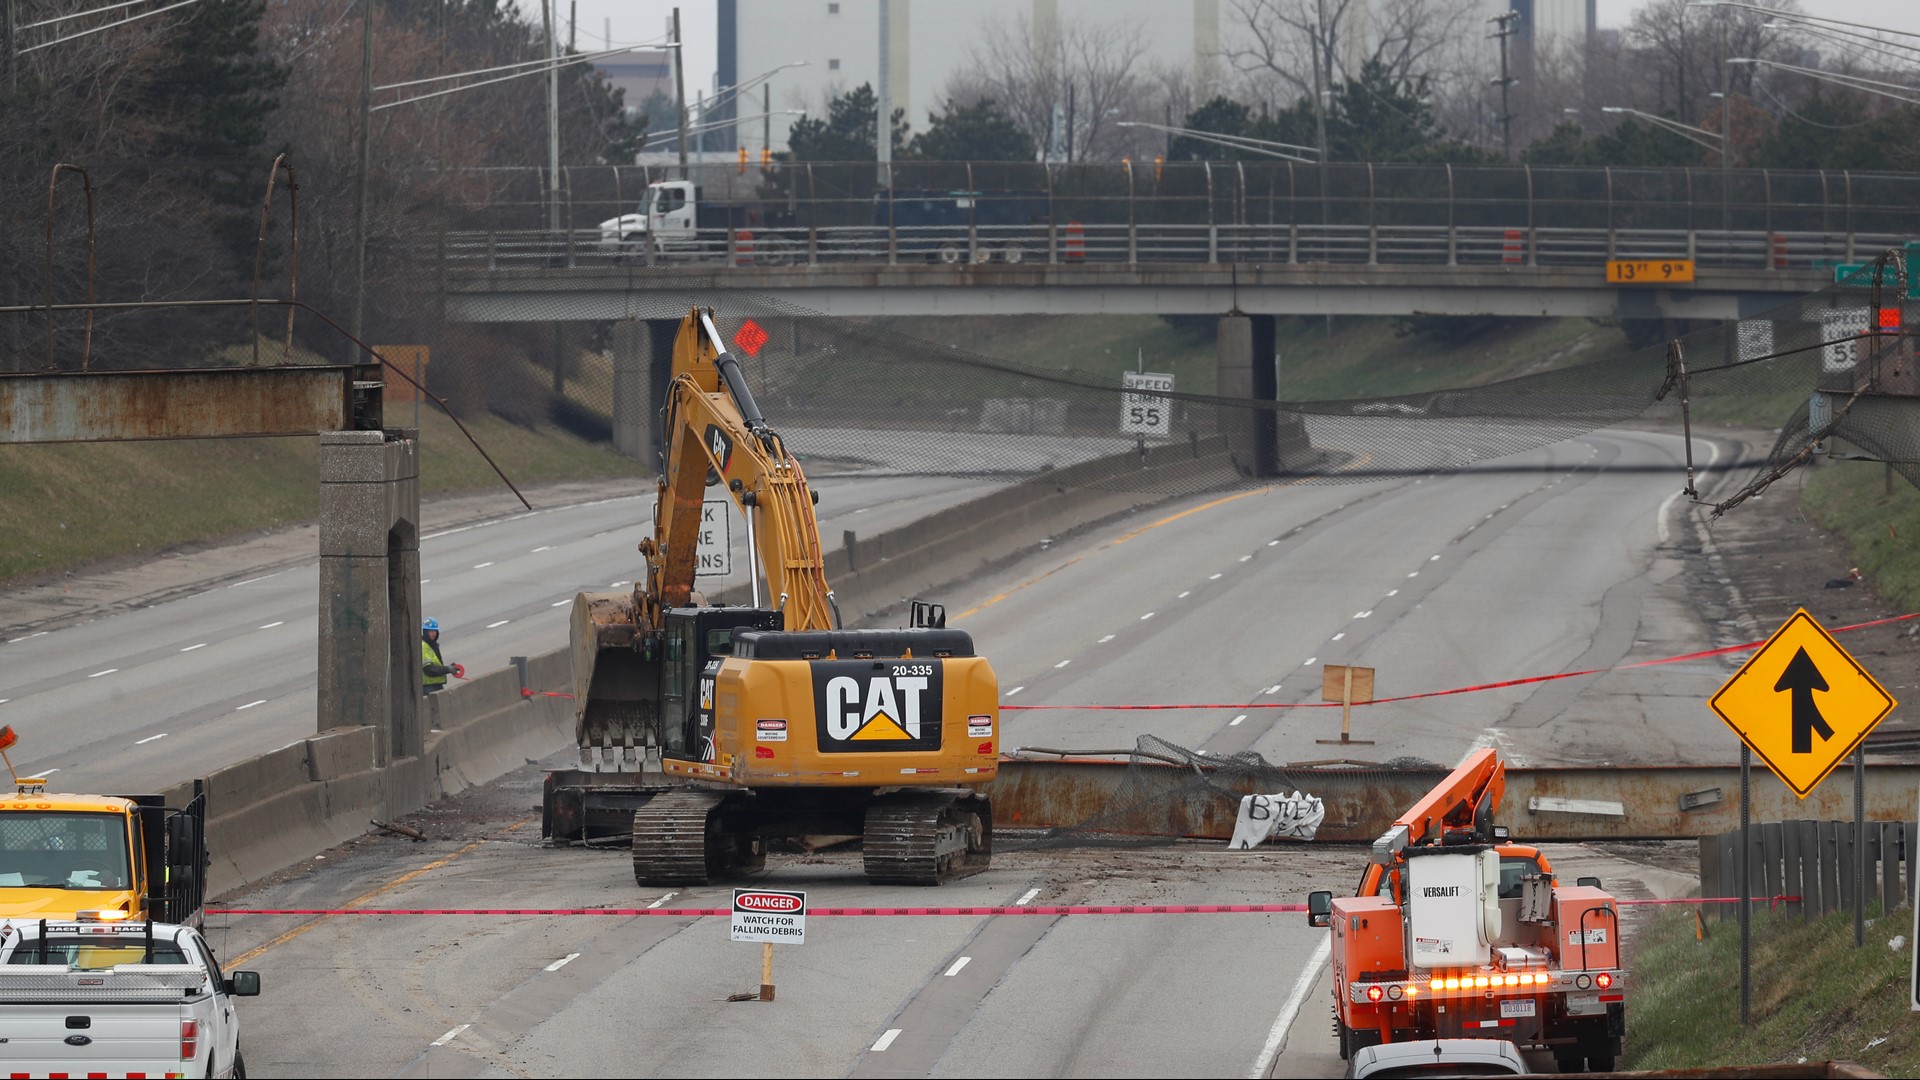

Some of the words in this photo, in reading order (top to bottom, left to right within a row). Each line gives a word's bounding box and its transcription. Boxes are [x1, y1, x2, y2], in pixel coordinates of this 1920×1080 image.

[1126, 378, 1171, 390] SPEED
[1130, 408, 1159, 426] 55
[713, 429, 726, 468] CAT
[892, 665, 933, 676] 20-335
[700, 678, 715, 710] CAT
[826, 676, 928, 740] CAT
[1423, 886, 1459, 898] VERSALIFT
[744, 896, 794, 909] DANGER
[743, 916, 774, 925] WATCH
[776, 917, 794, 926] FOR
[733, 925, 770, 935] FALLING
[771, 927, 803, 936] DEBRIS
